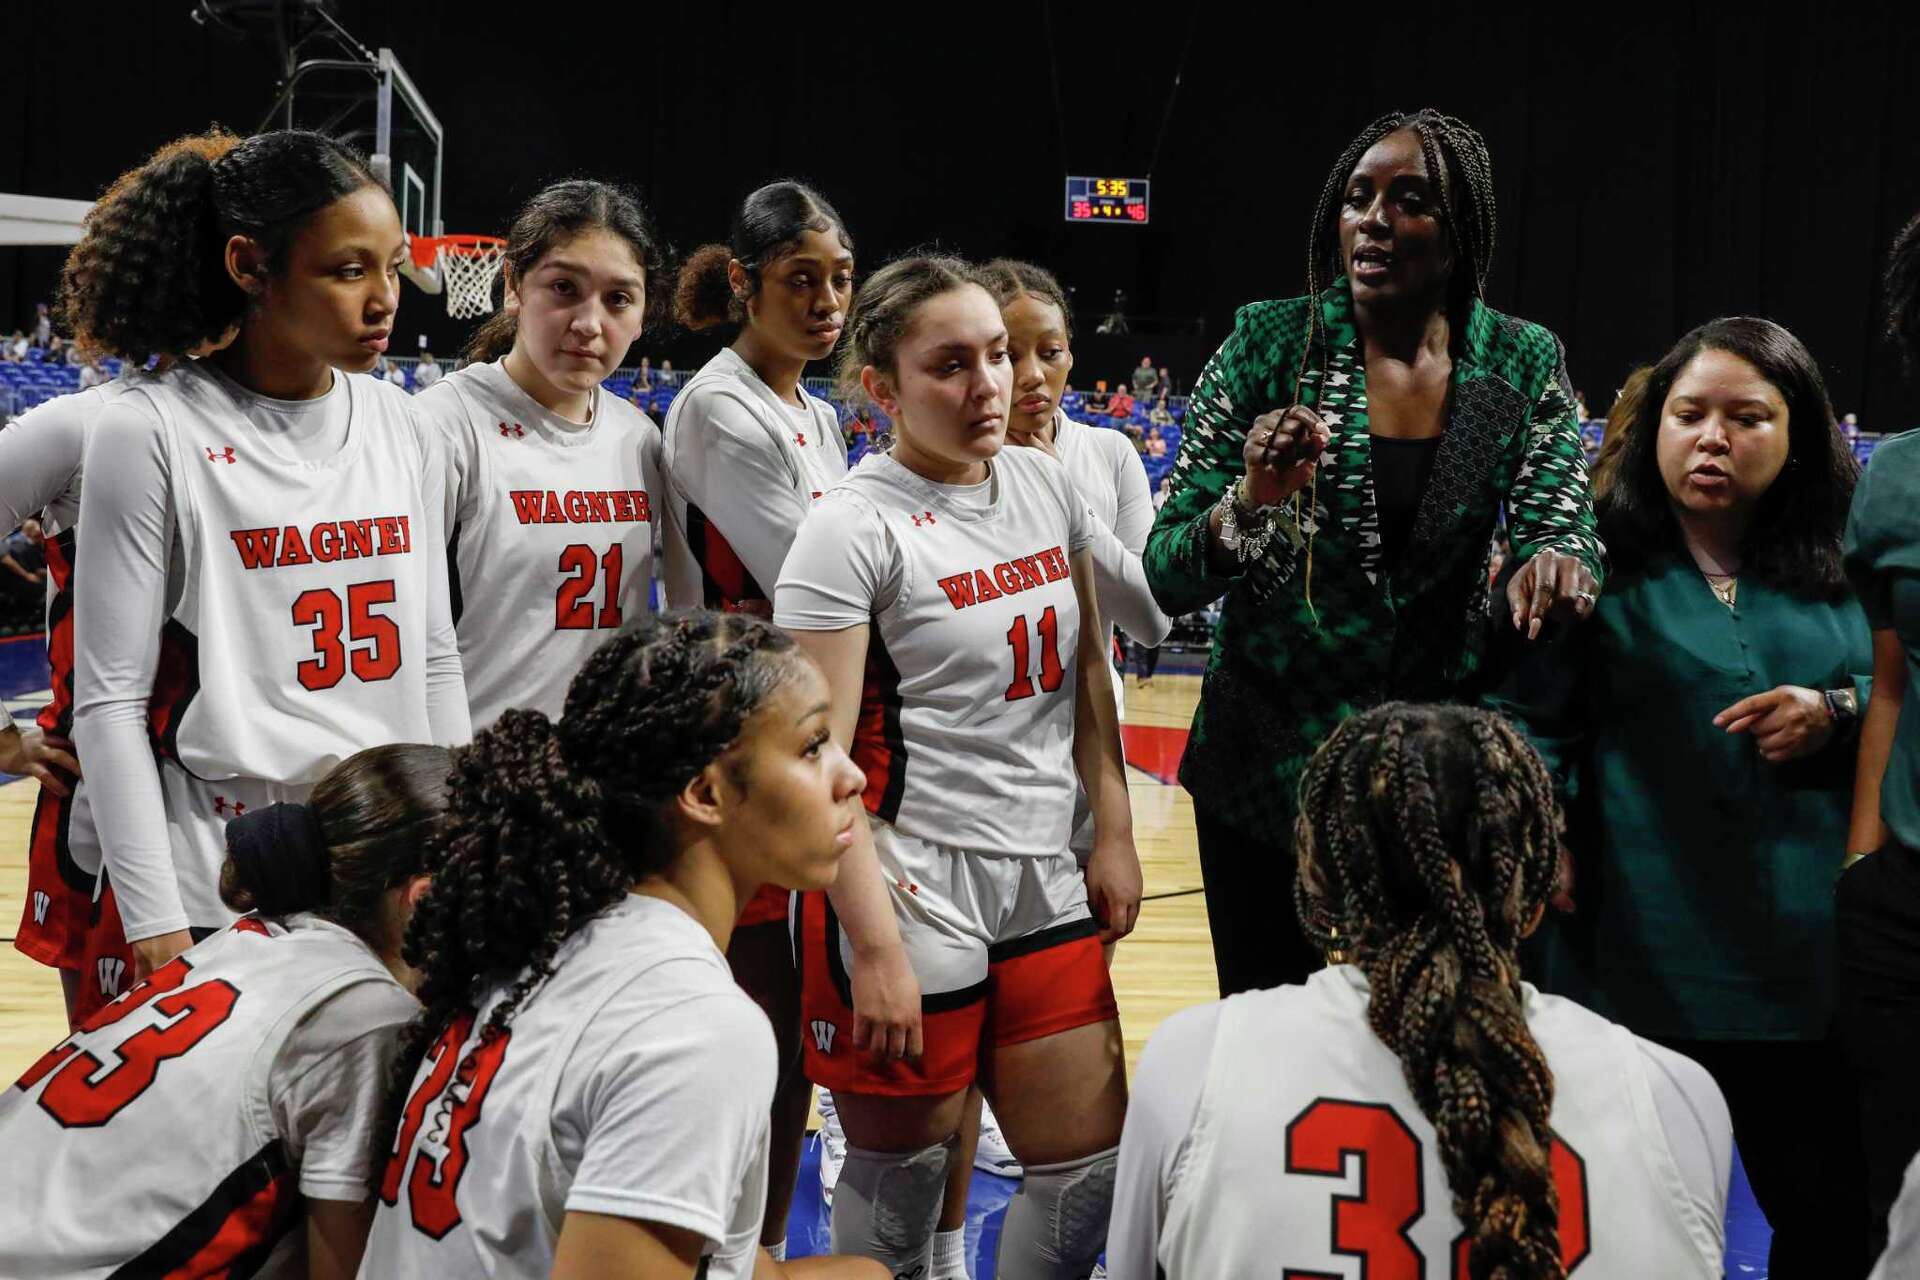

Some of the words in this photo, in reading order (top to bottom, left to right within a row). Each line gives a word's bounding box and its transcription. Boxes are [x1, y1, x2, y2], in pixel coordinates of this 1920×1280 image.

[1096, 179, 1127, 197] 5:35
[1072, 201, 1091, 218] 35
[1102, 204, 1112, 217] 4
[510, 490, 652, 524] WAGNER
[555, 543, 623, 630] 21
[291, 579, 401, 692] 35
[1005, 605, 1066, 702] 11
[33, 890, 51, 928] W
[97, 956, 127, 998] W
[810, 1020, 837, 1055] W
[1283, 1096, 1591, 1280] 3
